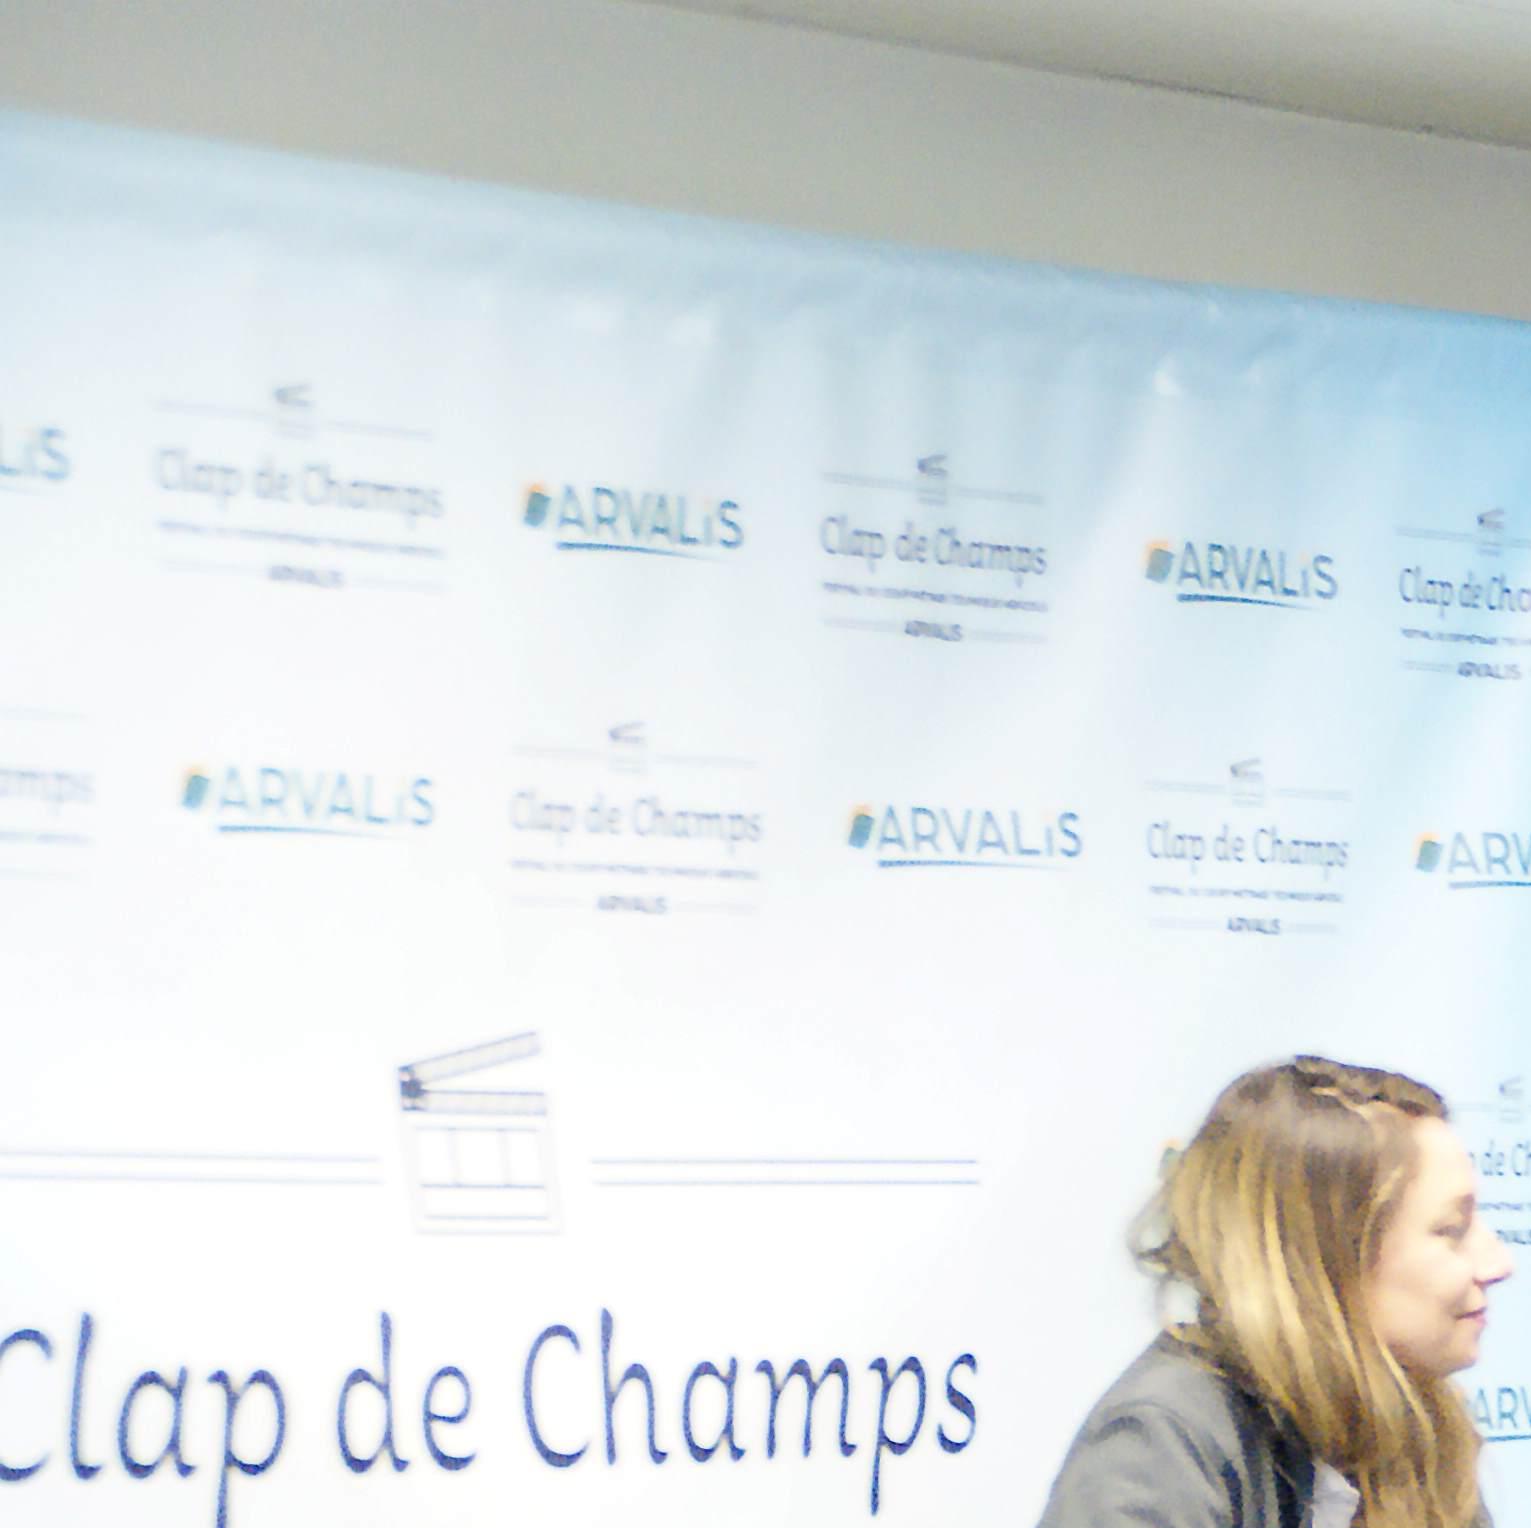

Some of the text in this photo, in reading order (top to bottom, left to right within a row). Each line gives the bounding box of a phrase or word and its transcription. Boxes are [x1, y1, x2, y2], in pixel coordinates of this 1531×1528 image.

[821, 514, 1048, 588] Clap de Champs
[1400, 565, 1453, 619] Clap
[1459, 570, 1482, 609] de
[1148, 821, 1349, 882] Clap de Champs
[1482, 1139, 1504, 1177] de
[337, 1311, 478, 1474] de
[524, 1307, 979, 1516] Champs
